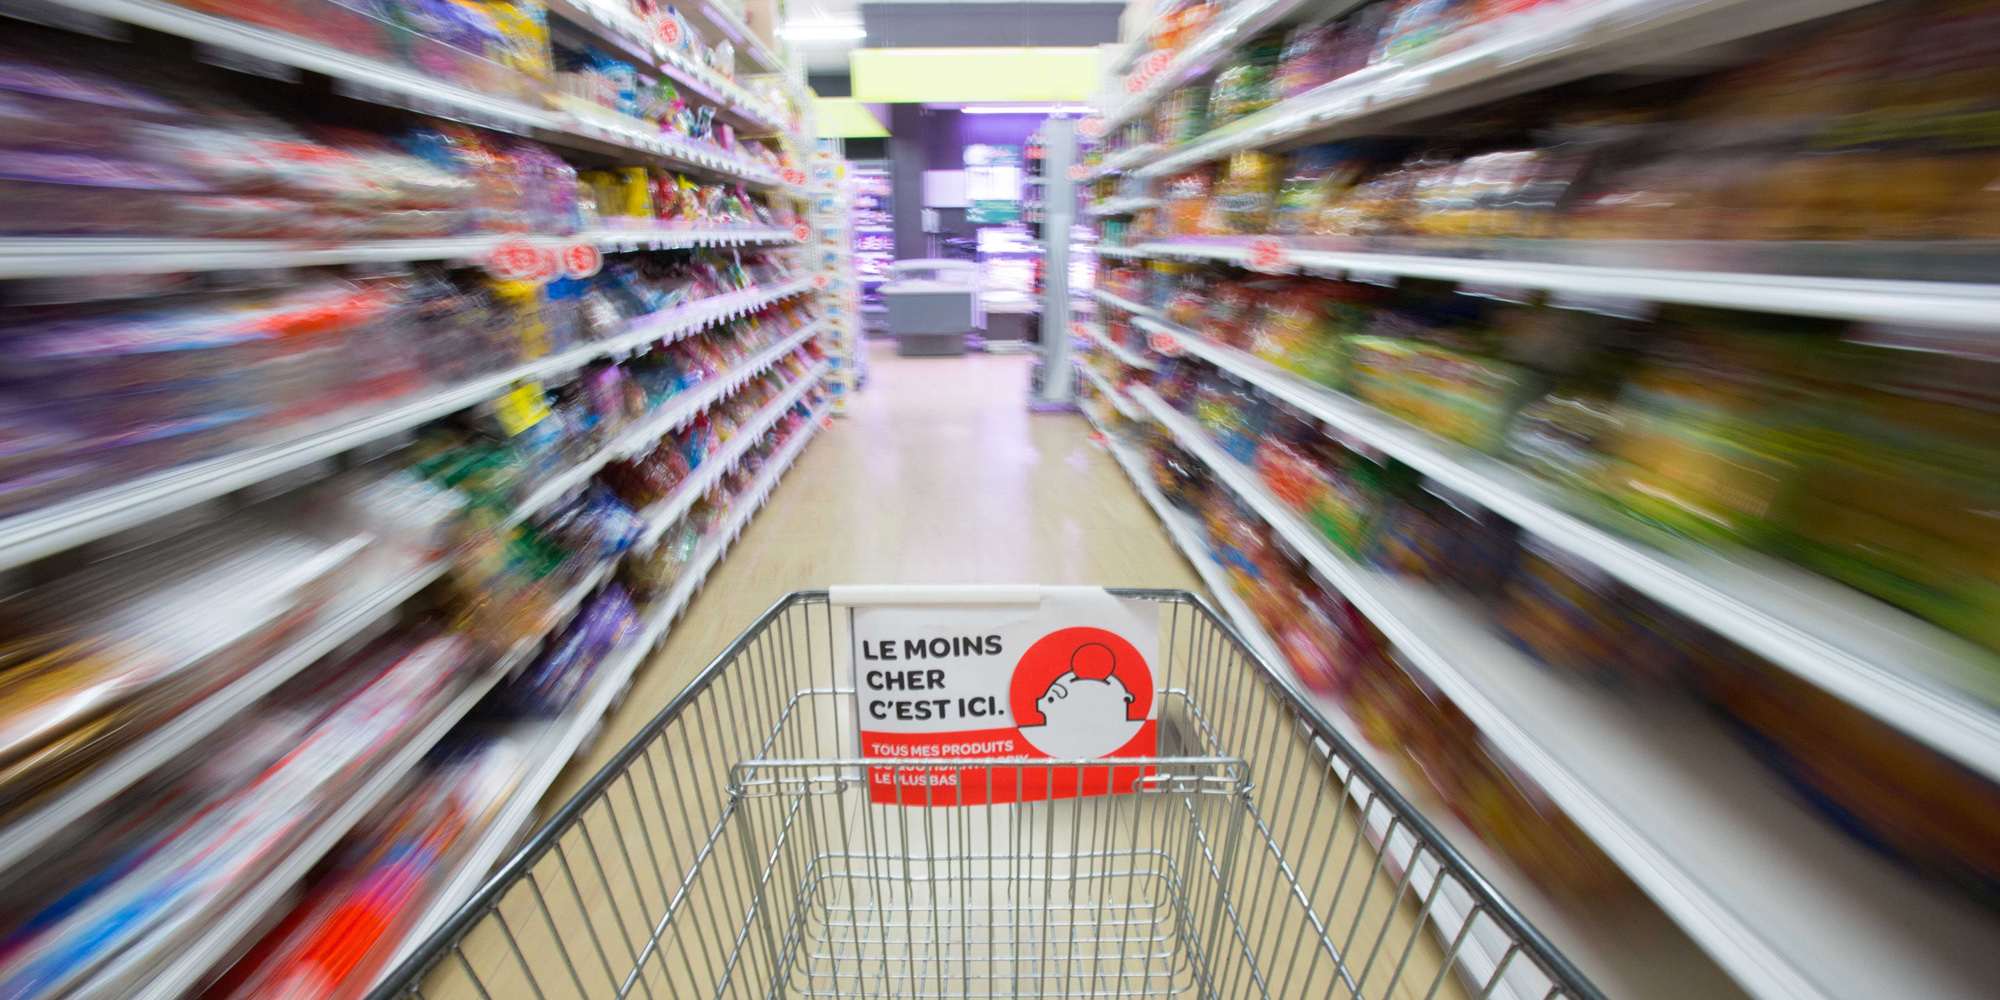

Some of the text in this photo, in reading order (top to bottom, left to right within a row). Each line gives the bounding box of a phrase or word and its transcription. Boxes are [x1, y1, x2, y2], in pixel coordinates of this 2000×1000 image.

[863, 634, 1003, 660] LE MOINS
[866, 669, 946, 691] CHER
[869, 695, 1005, 720] C'EST ICI.
[871, 740, 1014, 757] TOUS MES PRODUITS
[874, 772, 892, 785] LE
[929, 774, 957, 786] BAS
